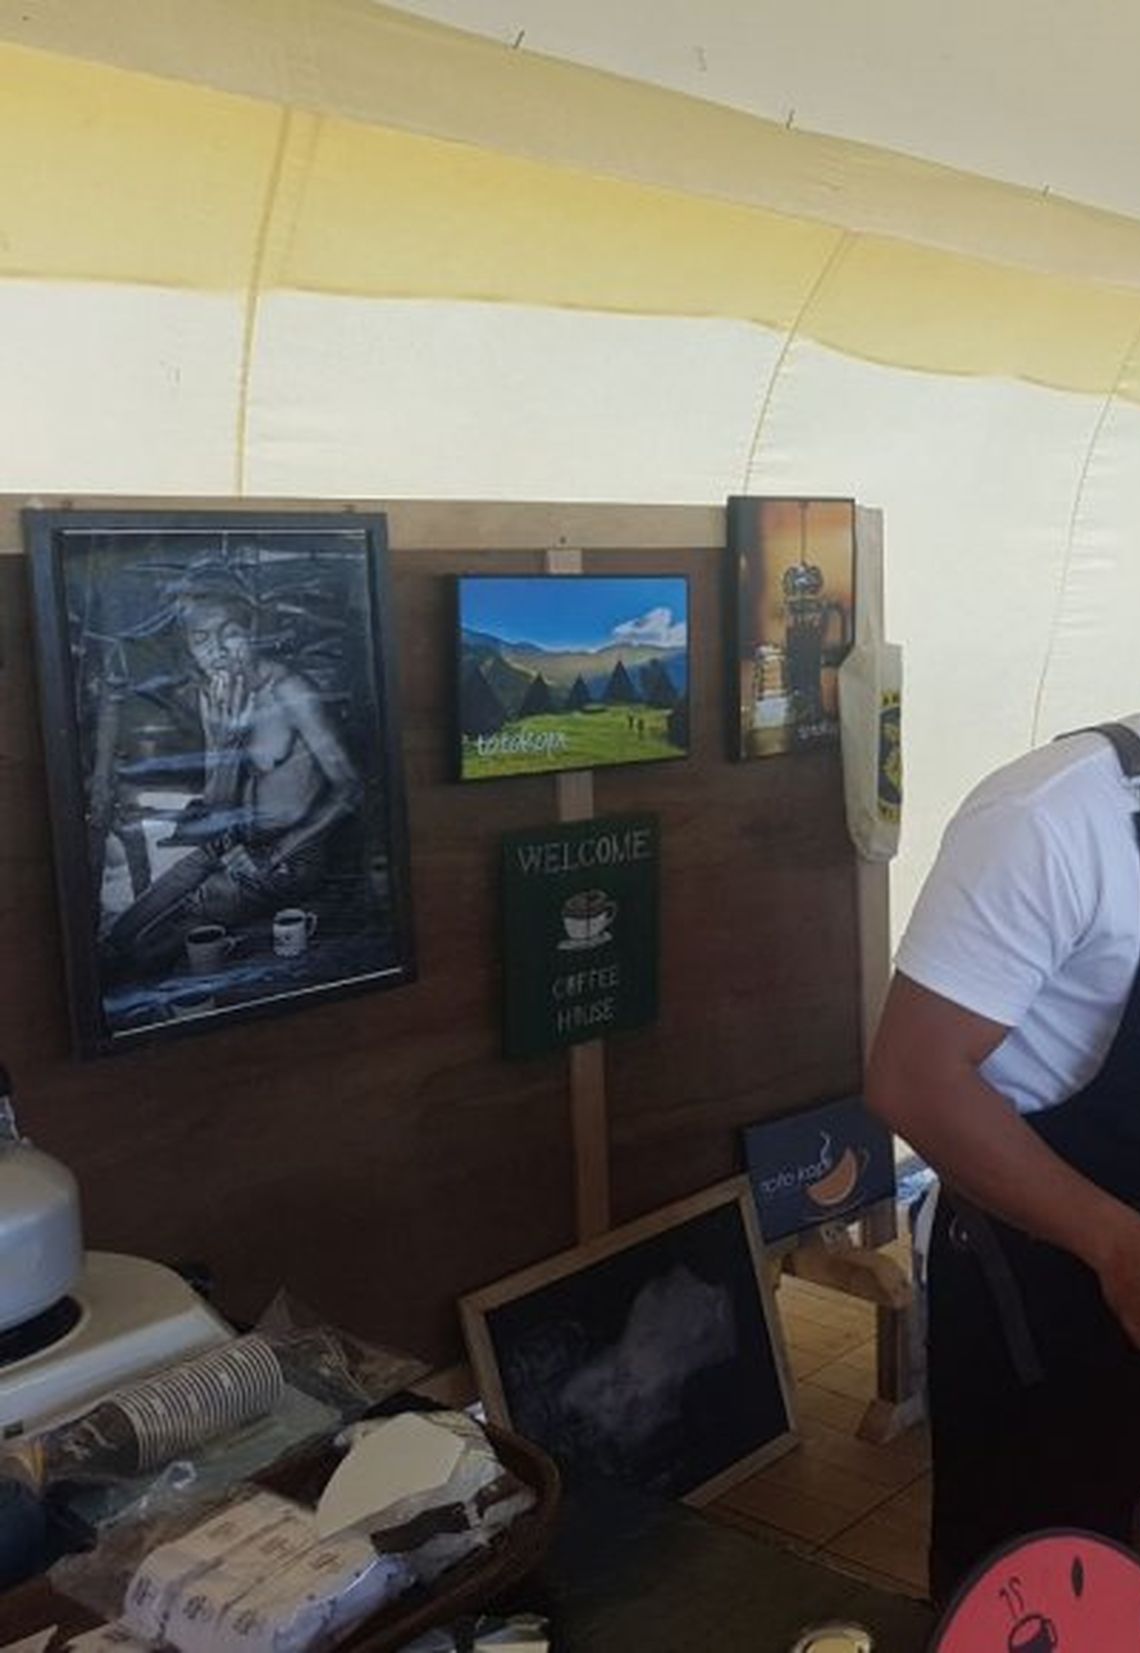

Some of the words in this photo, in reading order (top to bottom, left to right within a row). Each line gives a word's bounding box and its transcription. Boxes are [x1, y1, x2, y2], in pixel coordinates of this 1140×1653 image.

[516, 828, 651, 876] WELCOME
[552, 965, 619, 999] COFFEE
[556, 998, 616, 1034] HOUSE
